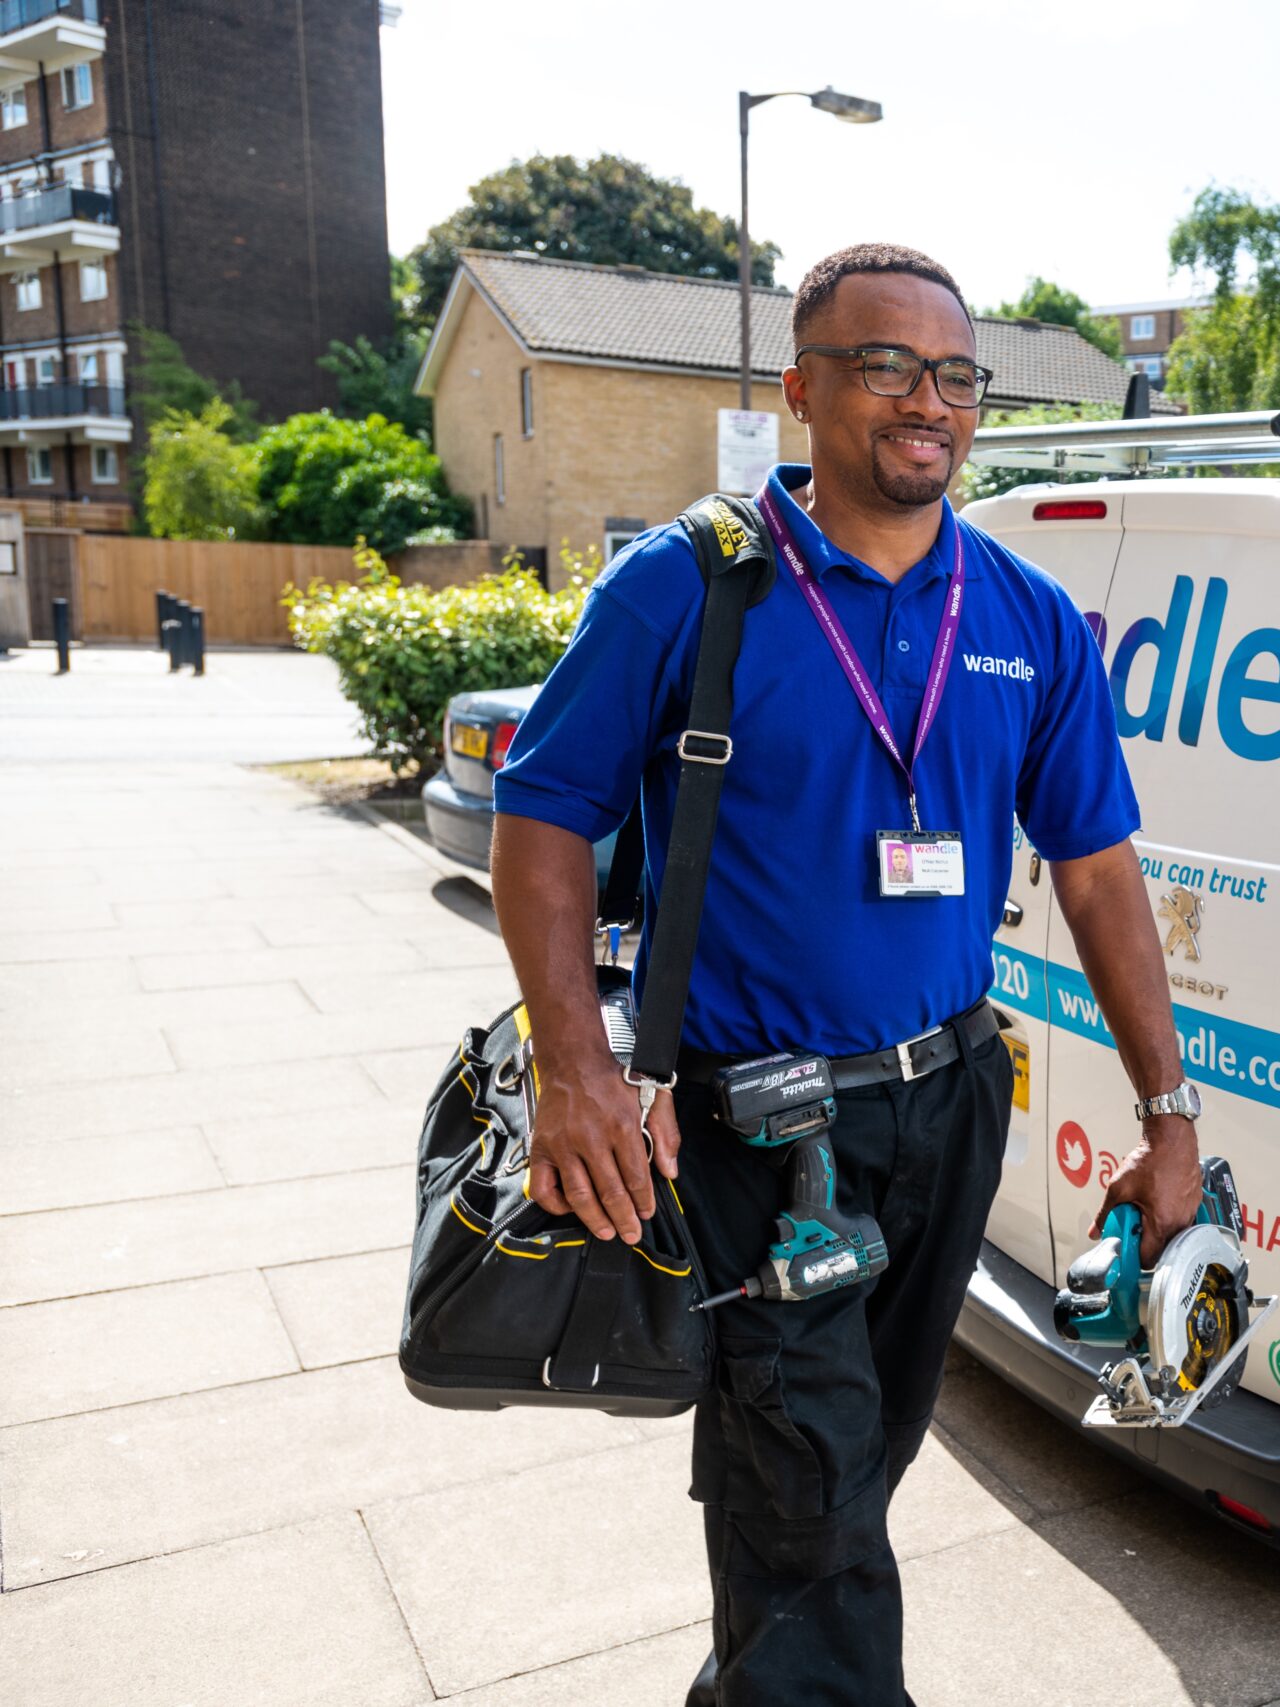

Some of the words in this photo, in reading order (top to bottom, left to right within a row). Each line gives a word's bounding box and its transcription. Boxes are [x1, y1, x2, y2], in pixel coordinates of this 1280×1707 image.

[783, 543, 805, 576] wandle
[950, 584, 962, 616] wandle
[817, 604, 829, 621] people
[827, 621, 838, 638] across
[836, 637, 846, 652] south
[844, 651, 855, 671] London
[853, 670, 861, 682] who
[859, 681, 869, 695] need
[932, 668, 942, 687] London
[963, 654, 1035, 682] wandle
[915, 843, 959, 854] wandle
[1138, 856, 1163, 879] ou
[1167, 863, 1204, 888] can
[1209, 867, 1267, 903] trust
[1170, 973, 1229, 1001] GEOT
